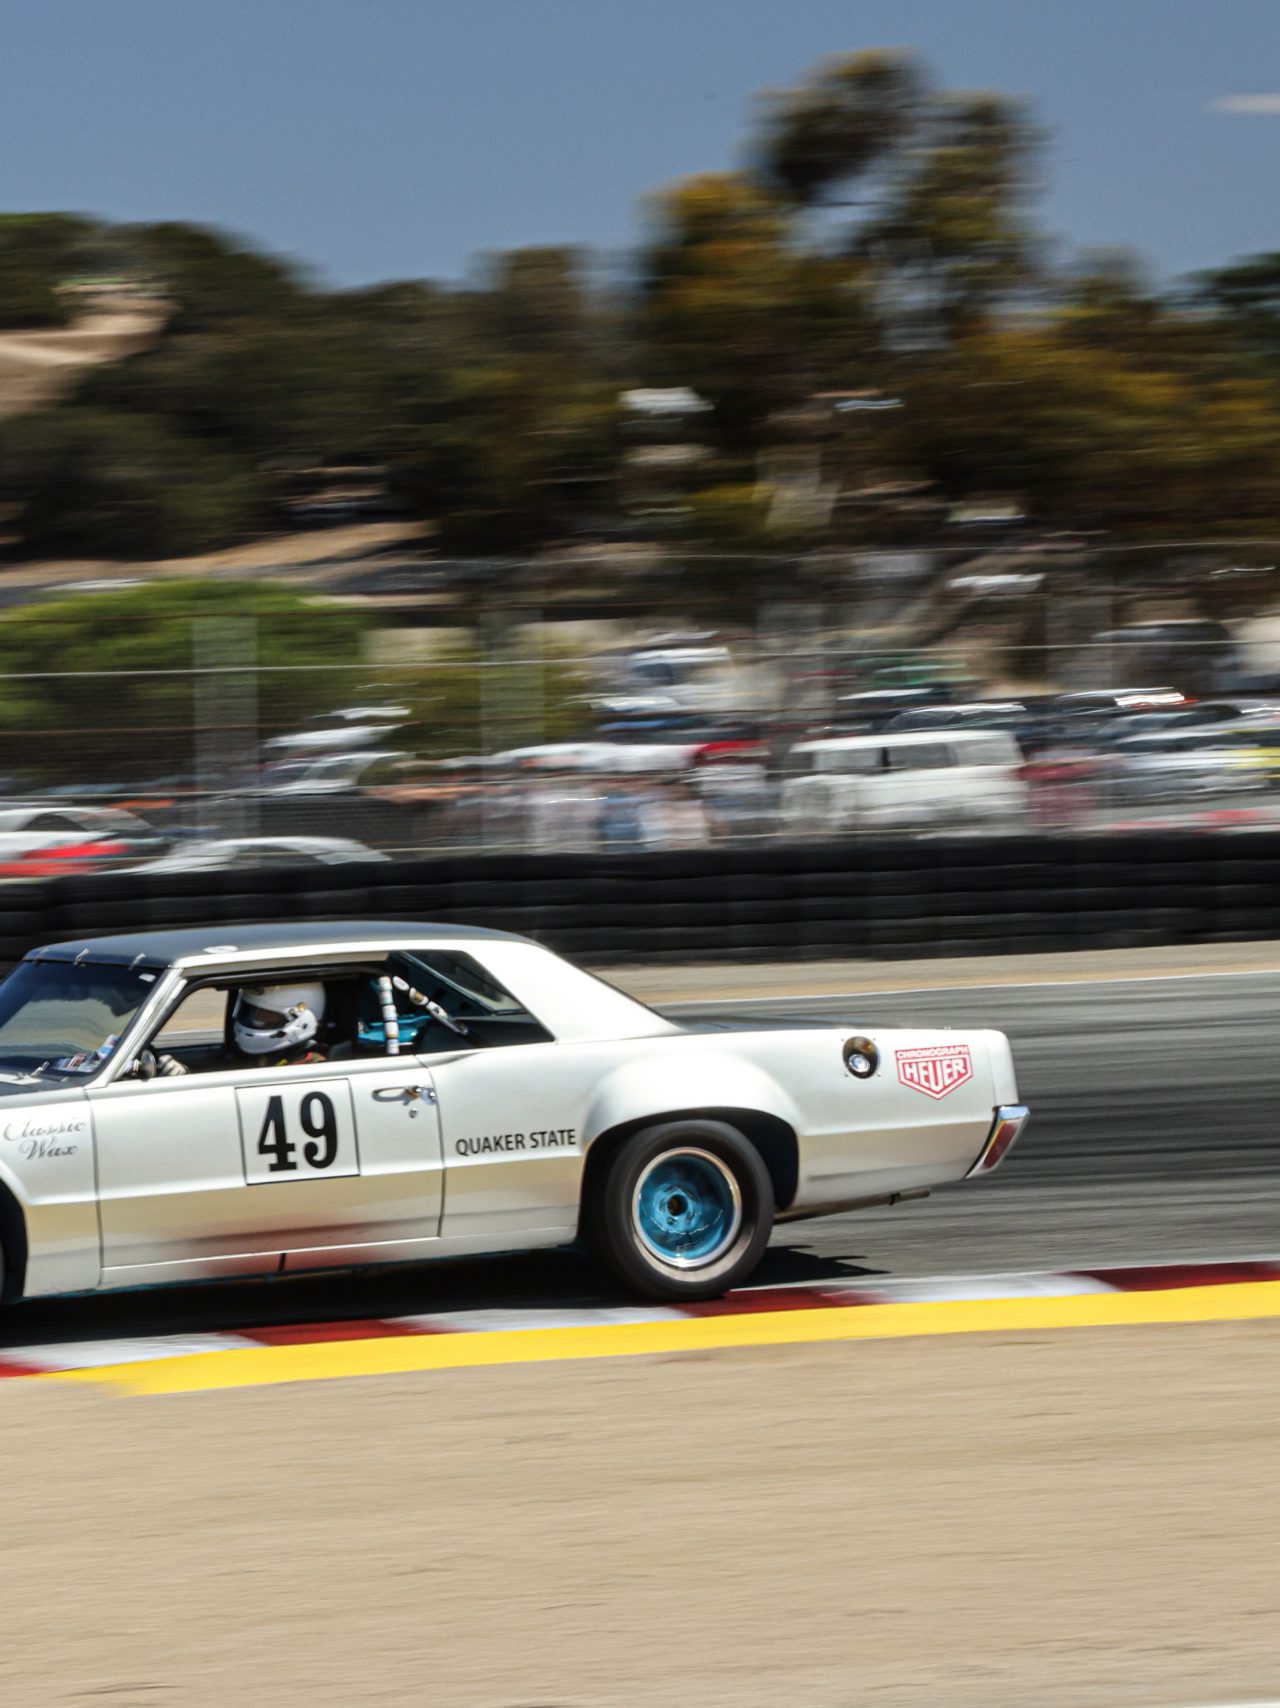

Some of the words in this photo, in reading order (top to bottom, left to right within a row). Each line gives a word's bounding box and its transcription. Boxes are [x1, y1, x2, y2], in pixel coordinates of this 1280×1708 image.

[904, 1058, 966, 1092] HEUER
[3, 1116, 85, 1141] Classic
[258, 1091, 337, 1172] 49
[19, 1136, 77, 1160] Wax
[455, 1133, 526, 1156] QUAKER
[529, 1129, 577, 1149] STATE
